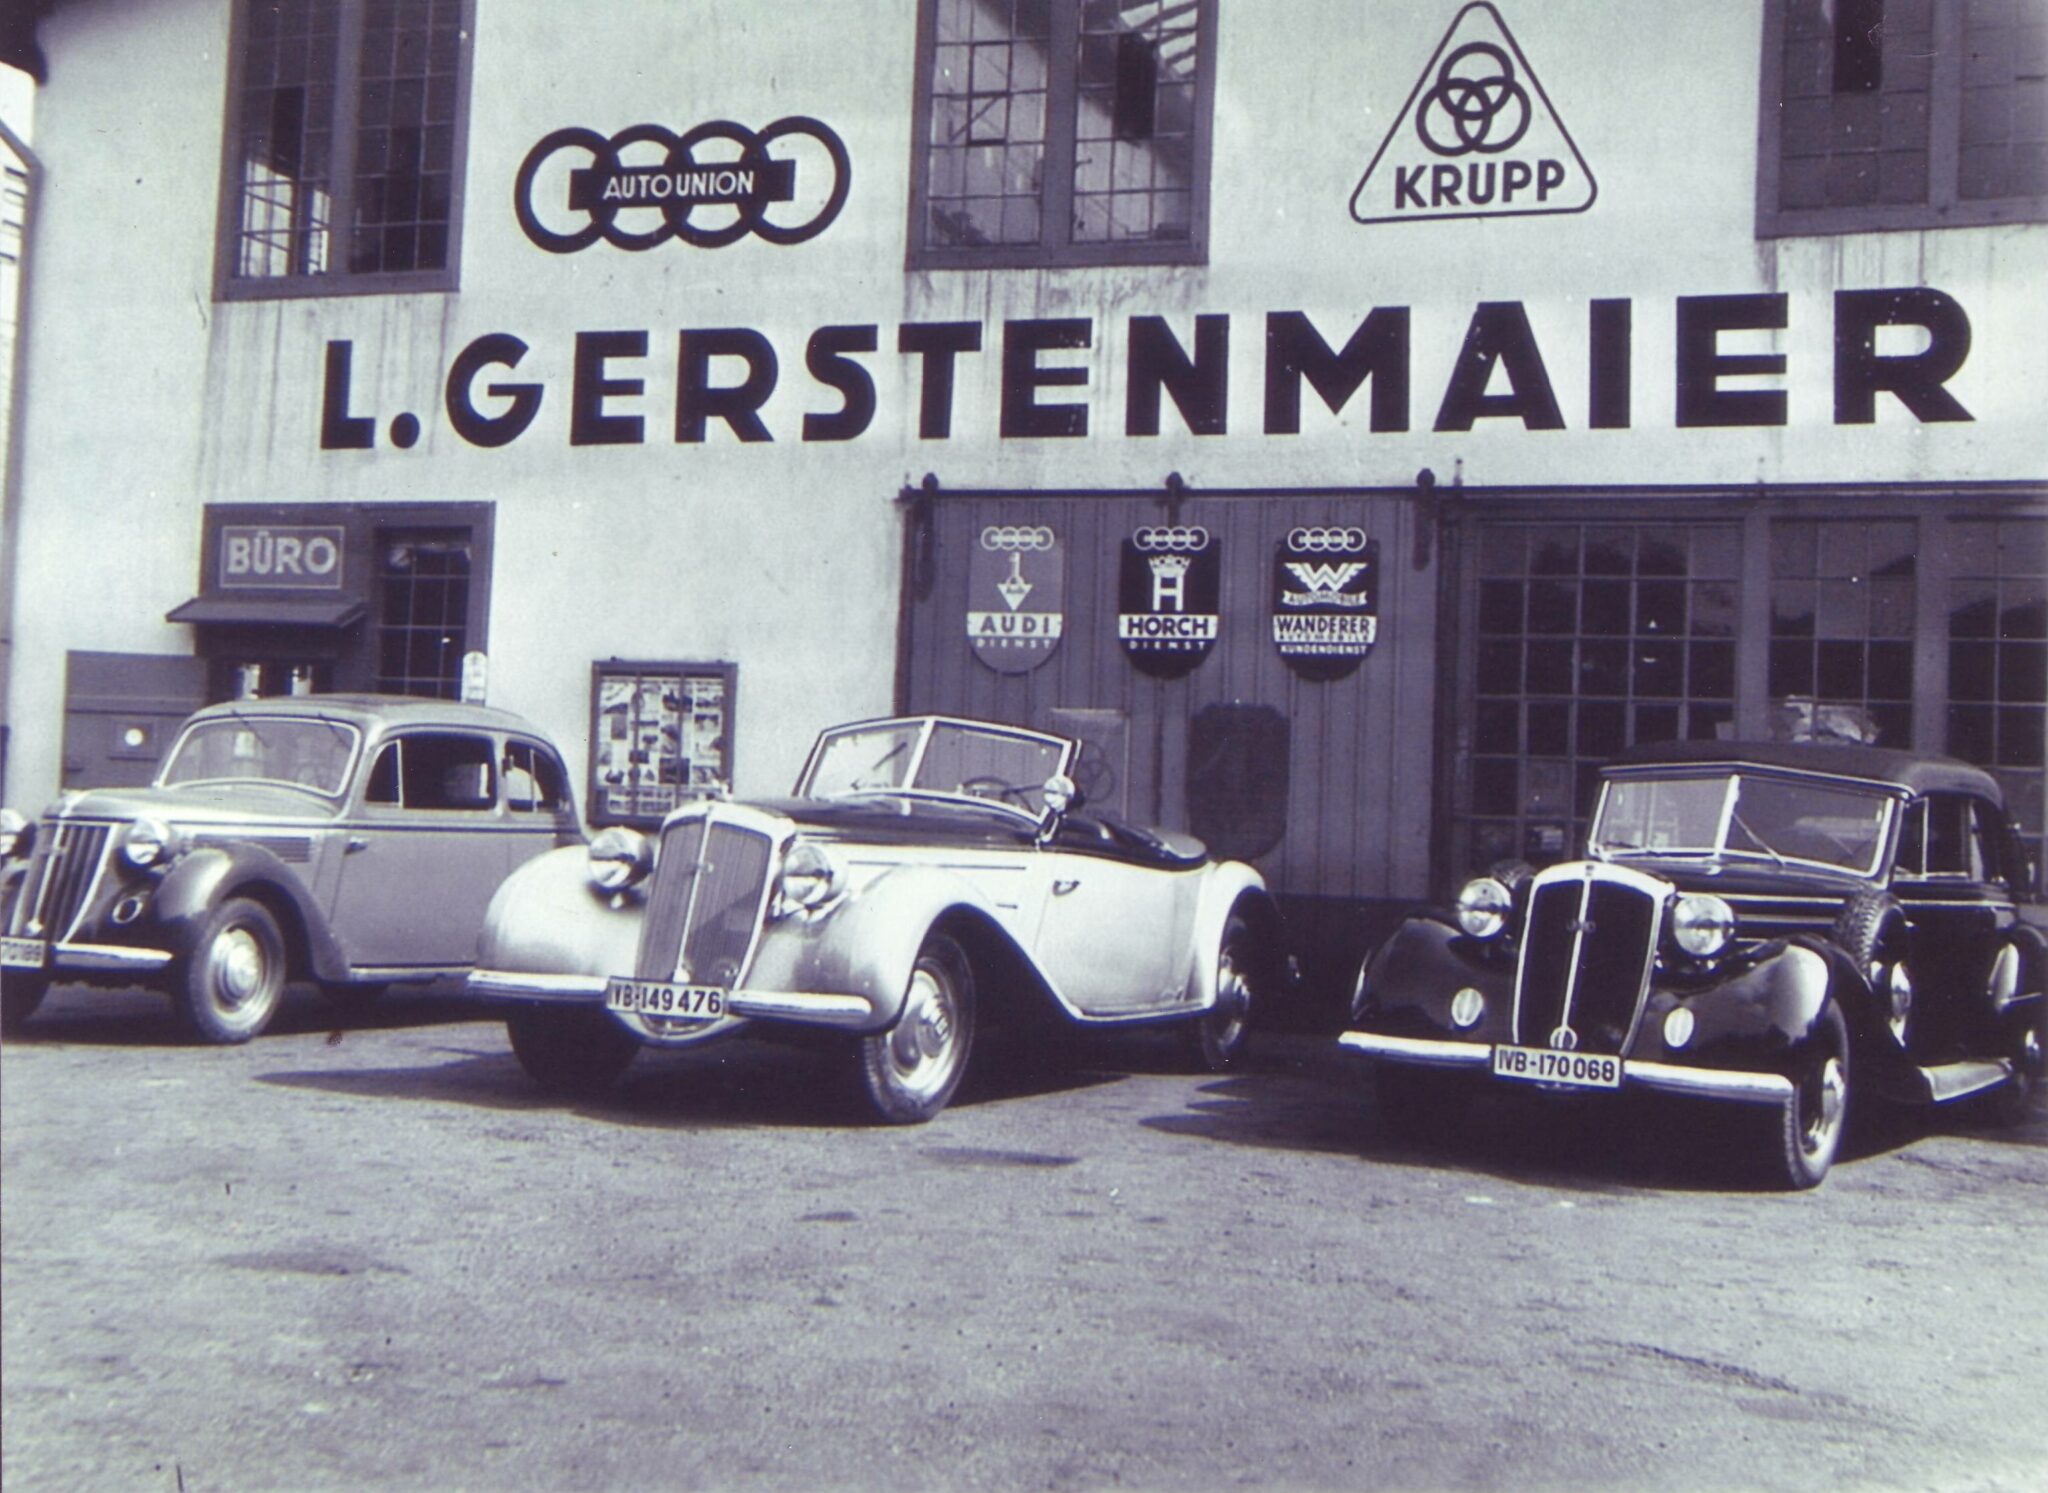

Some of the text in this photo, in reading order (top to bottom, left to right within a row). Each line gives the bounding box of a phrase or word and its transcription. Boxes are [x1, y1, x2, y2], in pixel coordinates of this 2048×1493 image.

[604, 171, 754, 200] AUTO UNION
[1394, 159, 1565, 209] KRUPP
[227, 531, 337, 575] BÜRO
[980, 615, 1049, 634] AUDI
[1127, 617, 1208, 636] HORCH
[1277, 617, 1370, 634] WANDERER
[1129, 640, 1205, 650] DIENST
